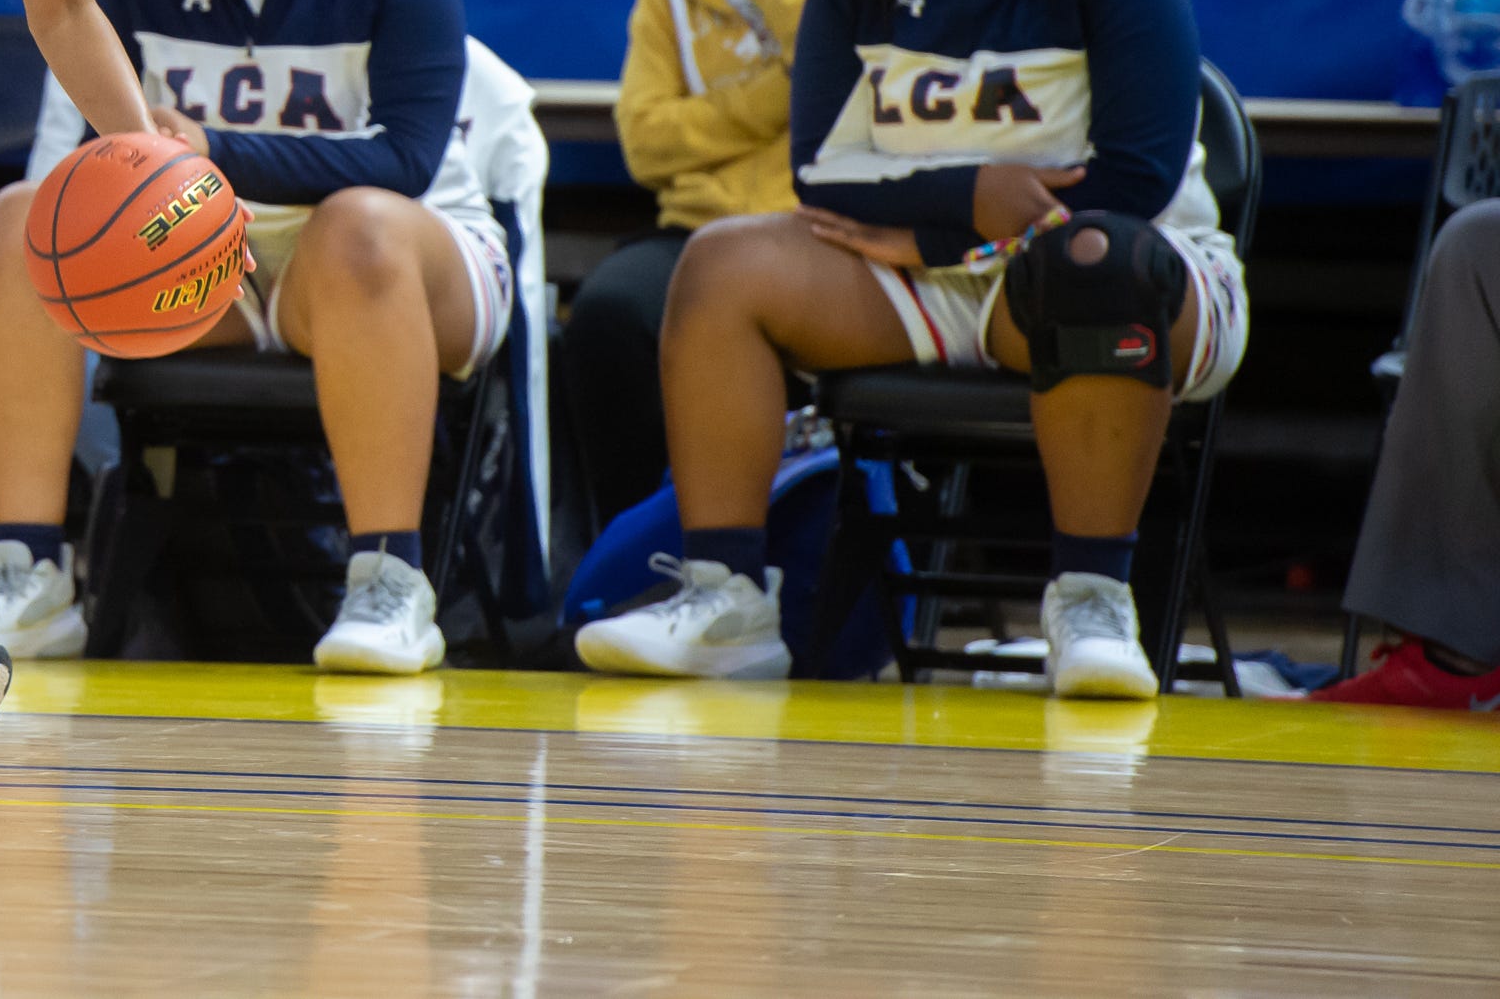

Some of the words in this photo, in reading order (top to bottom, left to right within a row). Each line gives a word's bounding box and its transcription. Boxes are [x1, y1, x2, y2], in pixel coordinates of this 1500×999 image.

[165, 64, 347, 131] LCA
[869, 66, 1043, 126] LCA
[137, 170, 223, 247] ELITE
